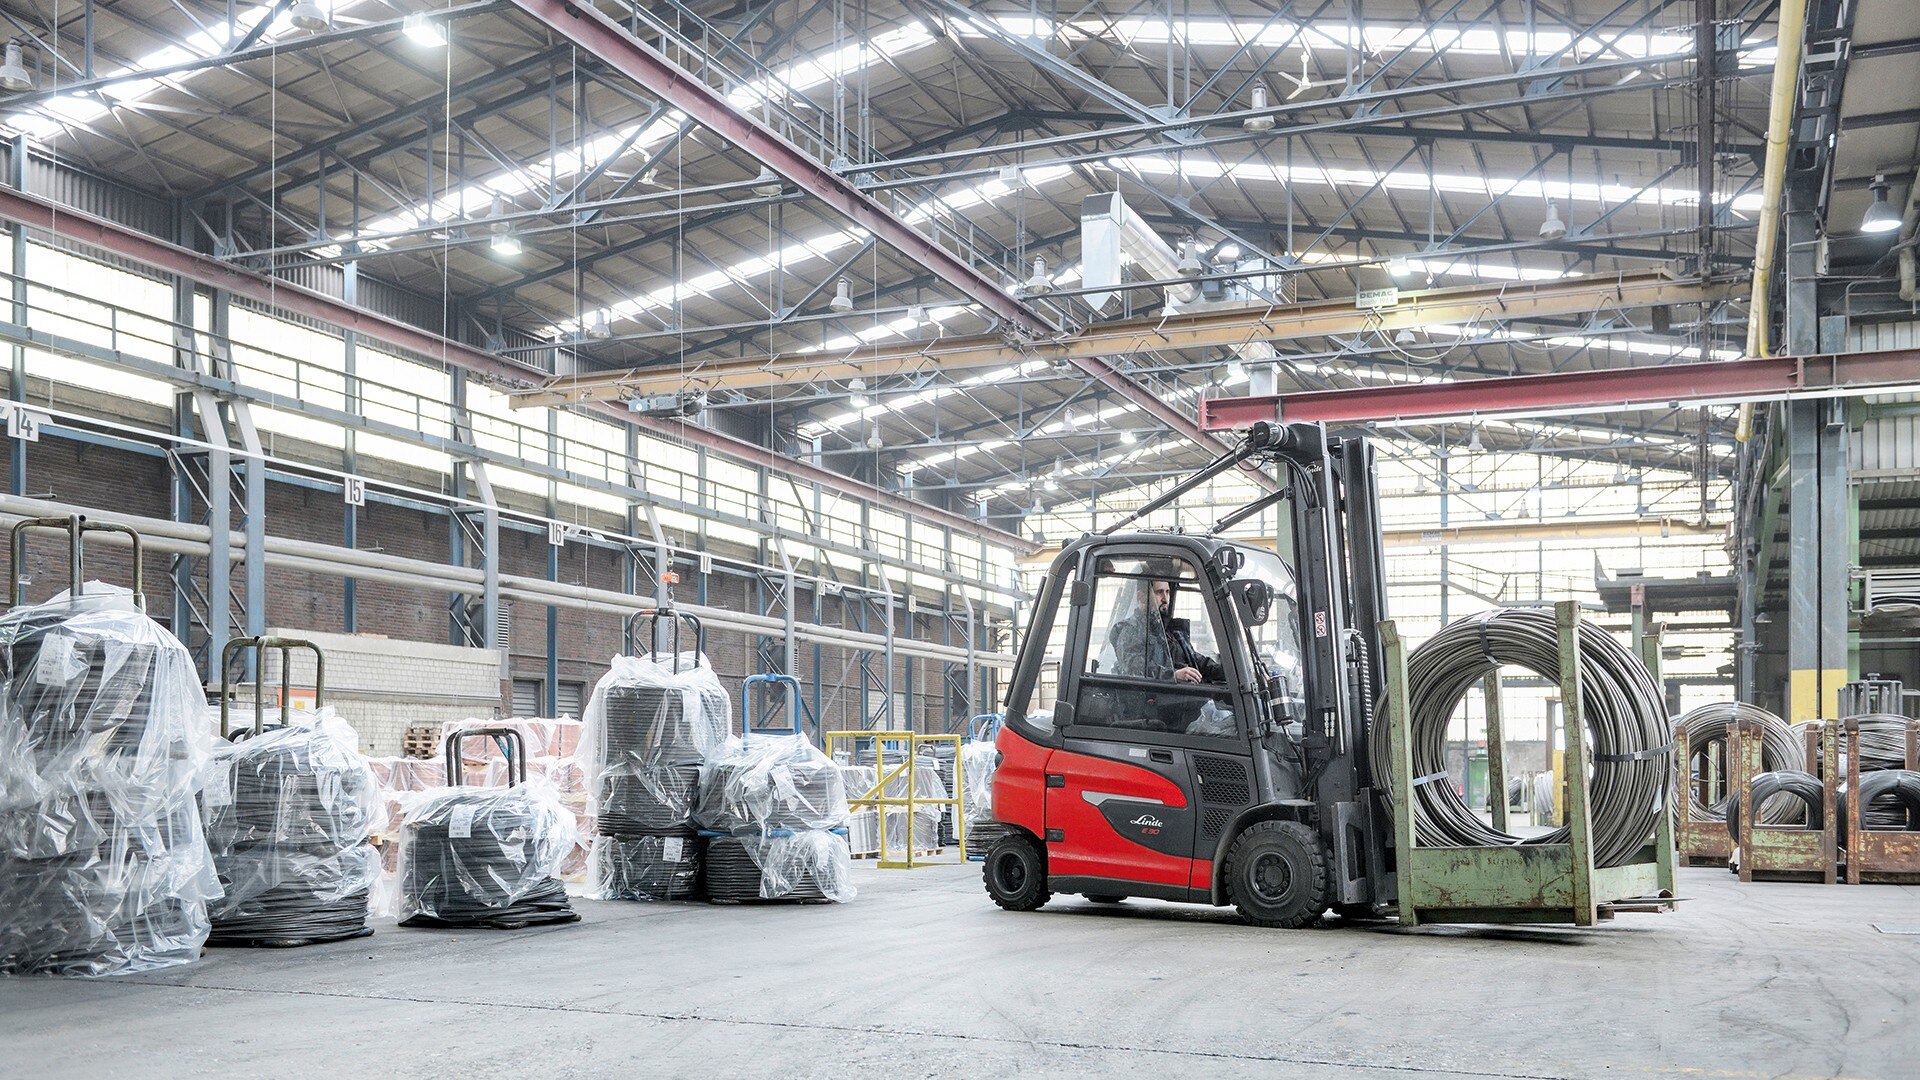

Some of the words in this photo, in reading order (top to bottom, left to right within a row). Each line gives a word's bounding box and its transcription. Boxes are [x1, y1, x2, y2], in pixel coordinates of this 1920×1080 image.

[1360, 290, 1394, 299] DEMAG
[14, 407, 33, 437] 14
[348, 478, 361, 502] 15
[551, 523, 562, 543] 16
[1130, 814, 1163, 827] Linde
